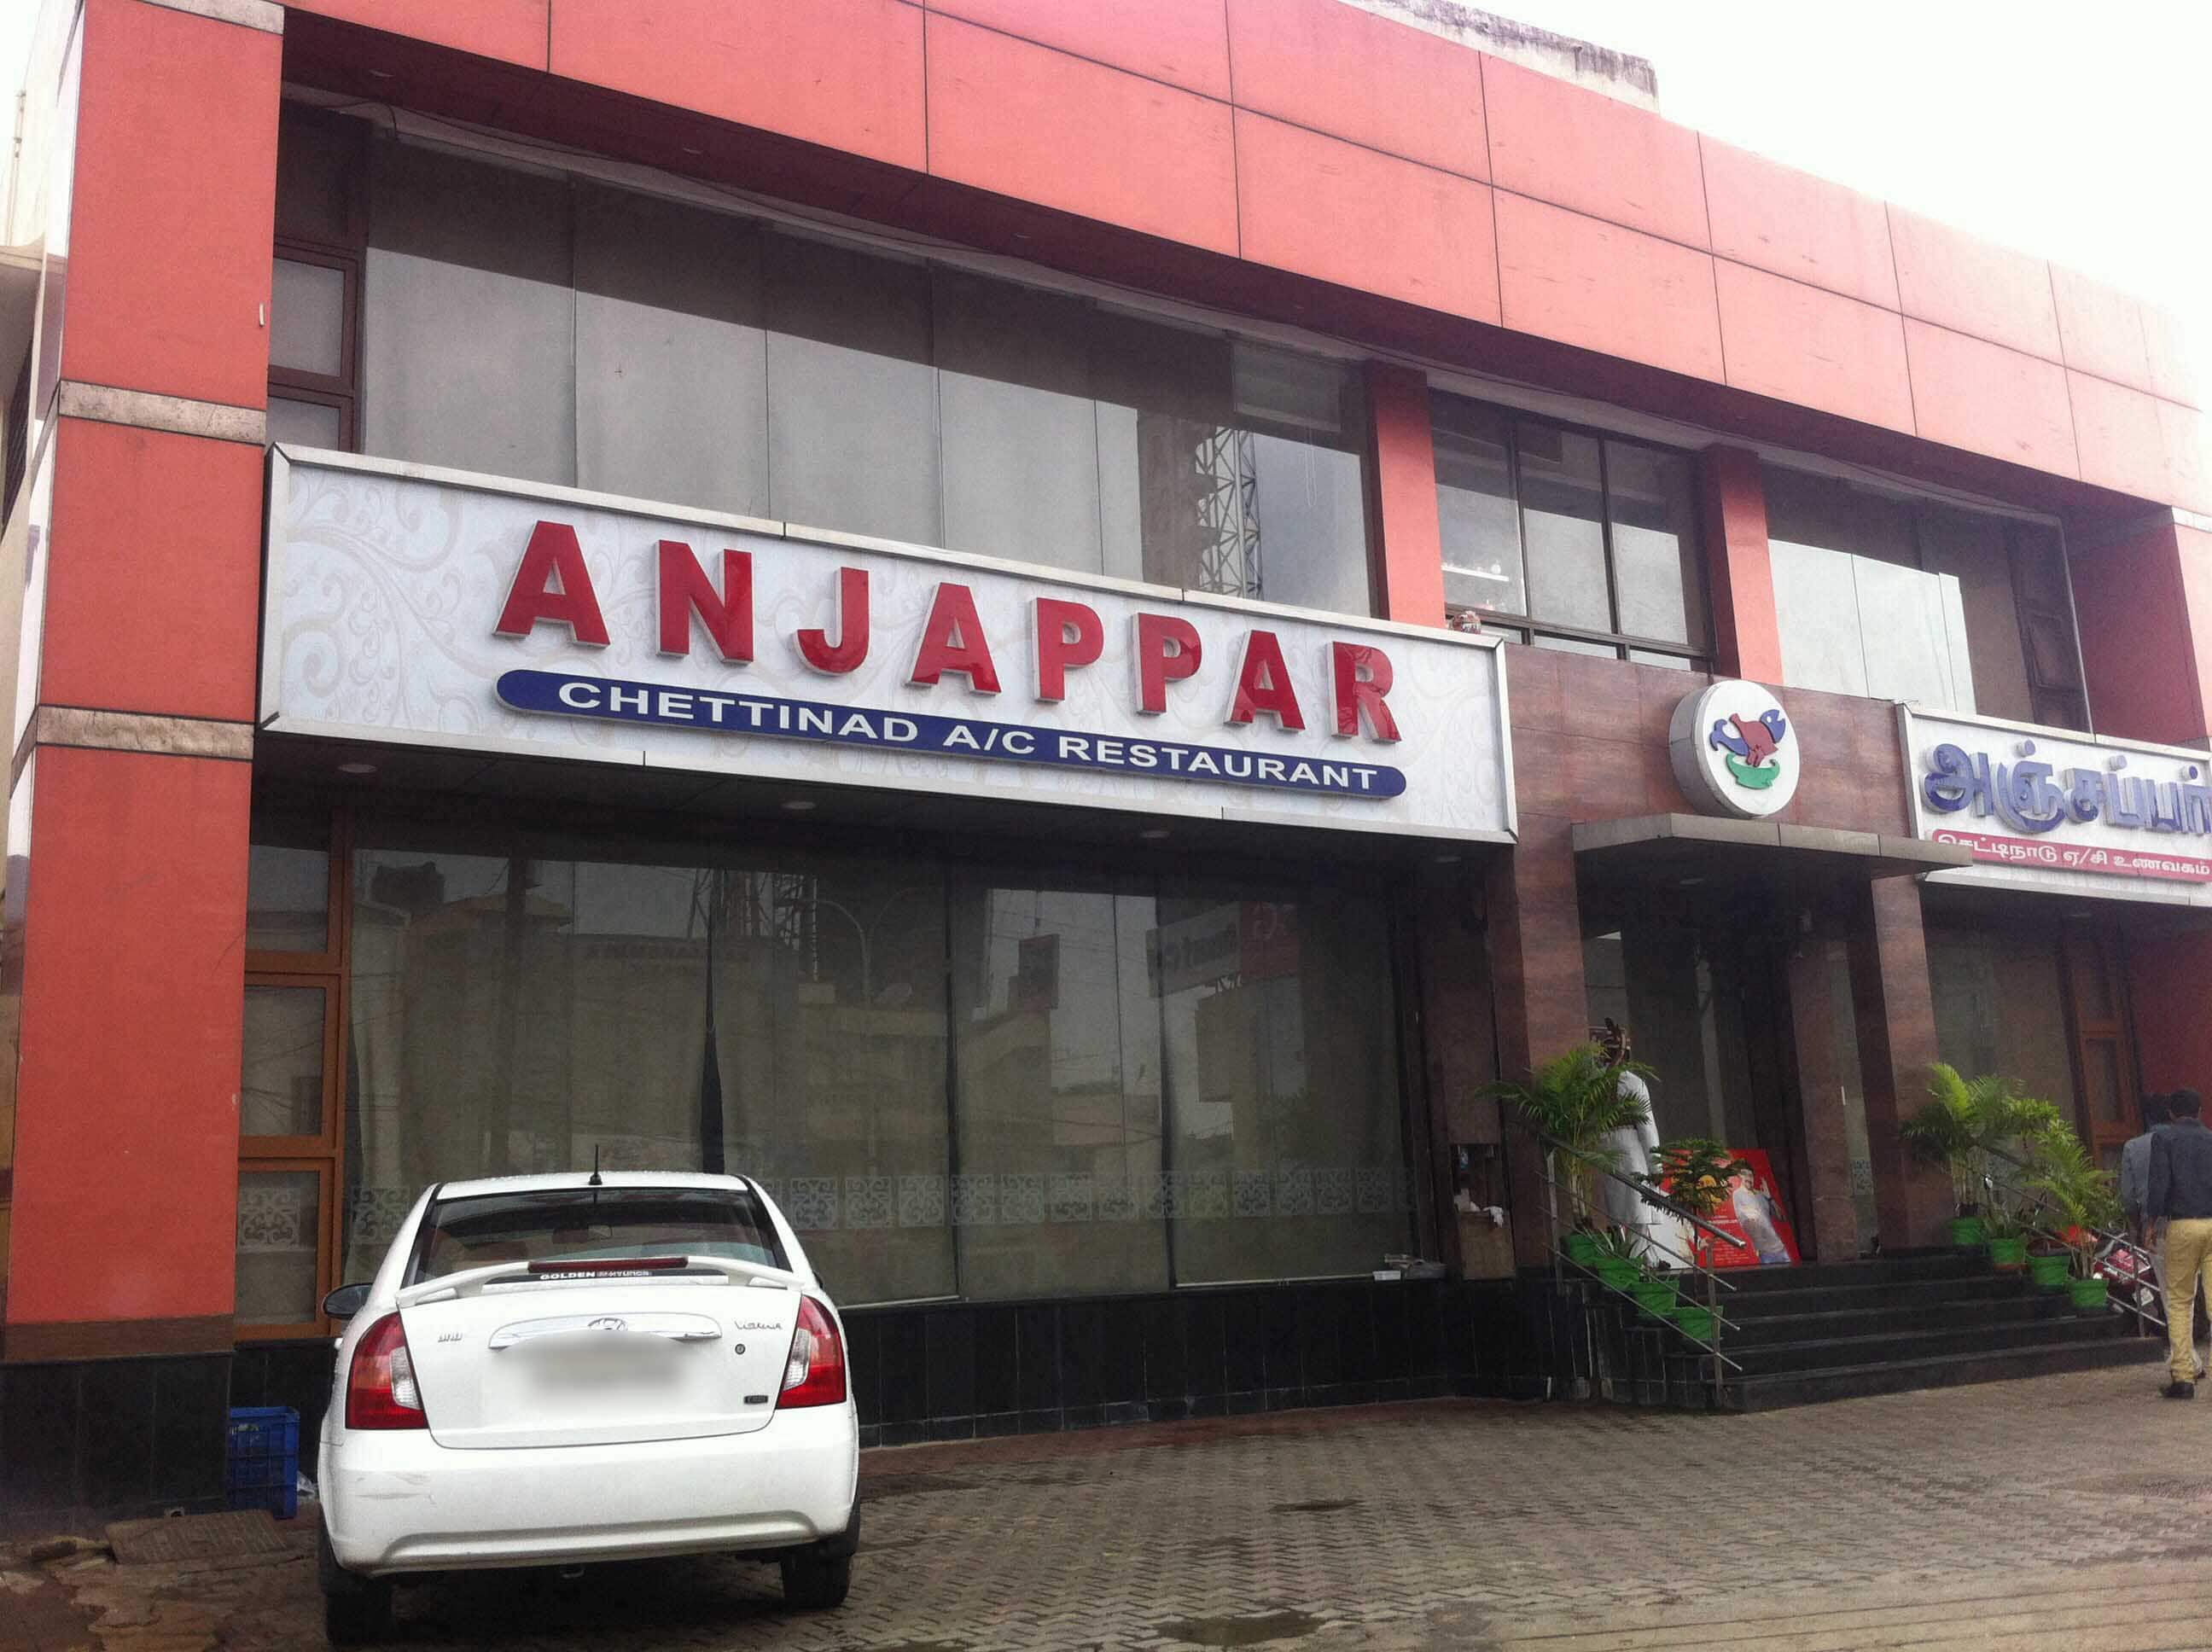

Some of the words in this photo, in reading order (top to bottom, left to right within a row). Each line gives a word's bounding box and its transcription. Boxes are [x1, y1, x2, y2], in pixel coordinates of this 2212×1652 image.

[494, 520, 1401, 743] ANJAPPAR
[557, 682, 919, 742] CHETTINAD
[942, 724, 1035, 756] A/C
[1059, 736, 1378, 791] RESTAURANT
[539, 1271, 596, 1280] GOLDEN
